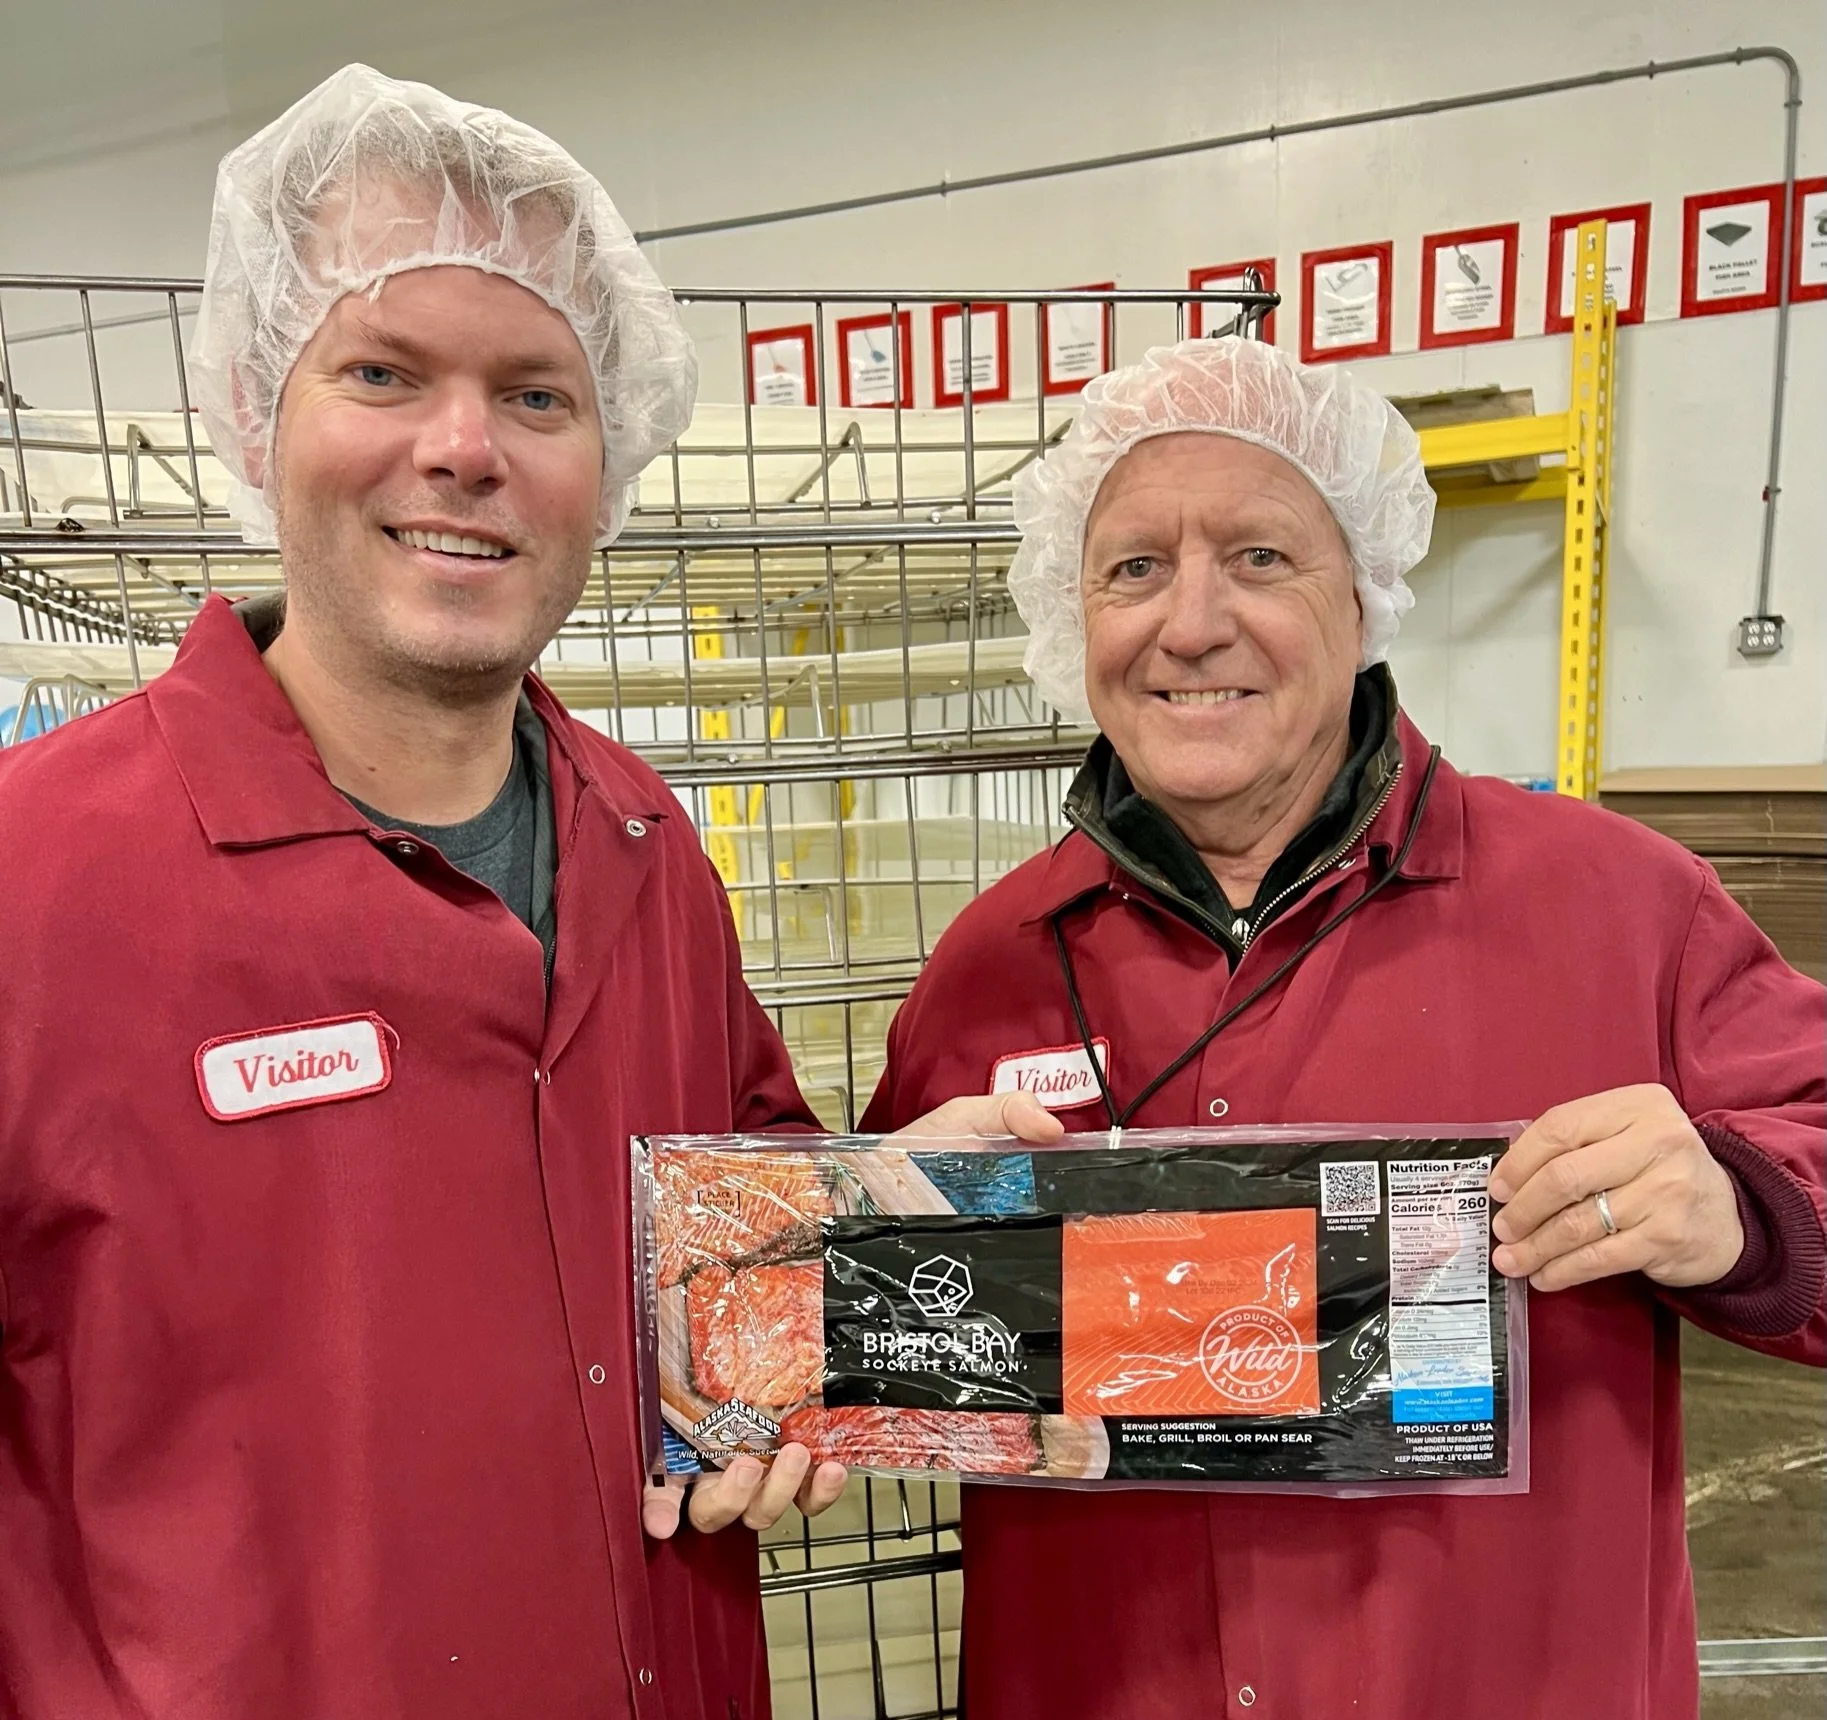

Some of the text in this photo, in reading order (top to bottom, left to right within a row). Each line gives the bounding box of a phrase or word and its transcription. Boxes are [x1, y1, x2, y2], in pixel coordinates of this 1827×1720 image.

[234, 1049, 360, 1093] Visitor
[1015, 1068, 1092, 1094] Visitor
[1390, 1162, 1449, 1173] Nutrition
[1391, 1196, 1487, 1213] Calories 260
[1219, 1312, 1290, 1338] PRODUCT OF
[863, 1332, 1021, 1354] BRISTOL BAY
[1206, 1333, 1294, 1375] Wild
[862, 1358, 1019, 1373] SOCKEYE SALMON
[1216, 1377, 1284, 1398] ALASKA
[1434, 1390, 1454, 1398] VISIT
[694, 1397, 782, 1437] ALASKA SEAFOOD
[1121, 1422, 1216, 1431] SERVING SUGGESTION
[1396, 1422, 1494, 1434] PRODUCT OF USA
[1122, 1433, 1313, 1444] BAKE, GRILL, BROIL OR PAN SEAR
[1424, 1436, 1446, 1444] UNDER
[1446, 1434, 1494, 1444] REFRIGERATION
[1412, 1444, 1454, 1453] IMMEDIATELY
[1454, 1444, 1478, 1452] BEFORE
[1394, 1455, 1411, 1463] KEEP
[1411, 1454, 1436, 1462] FROZEN
[1436, 1454, 1445, 1462] AT
[1462, 1453, 1472, 1461] OR
[1473, 1452, 1494, 1461] BELOW
